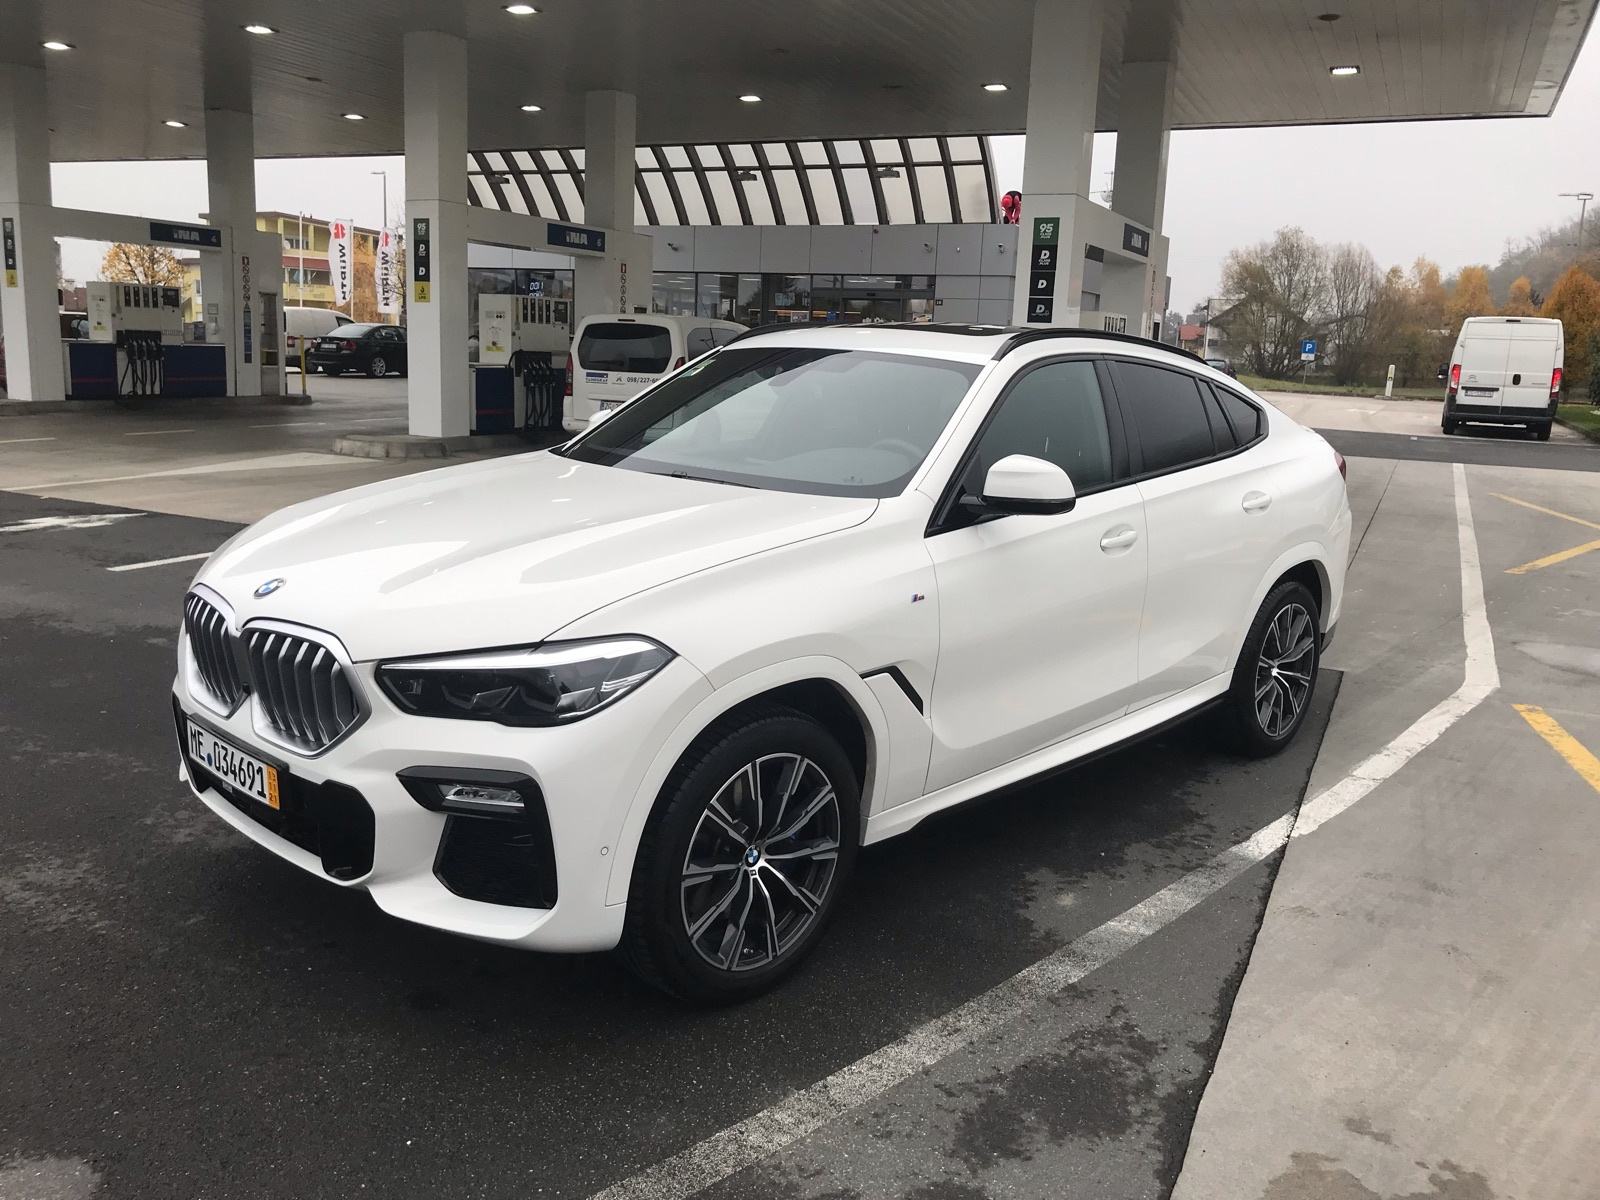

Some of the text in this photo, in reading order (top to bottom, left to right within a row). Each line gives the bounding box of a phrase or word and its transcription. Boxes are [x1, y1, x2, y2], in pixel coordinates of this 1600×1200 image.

[1039, 223, 1054, 233] 95
[1040, 250, 1050, 259] D
[418, 267, 426, 276] D
[1037, 279, 1047, 289] D
[1035, 304, 1045, 313] D
[1305, 343, 1313, 352] P
[190, 726, 267, 799] ME 034691
